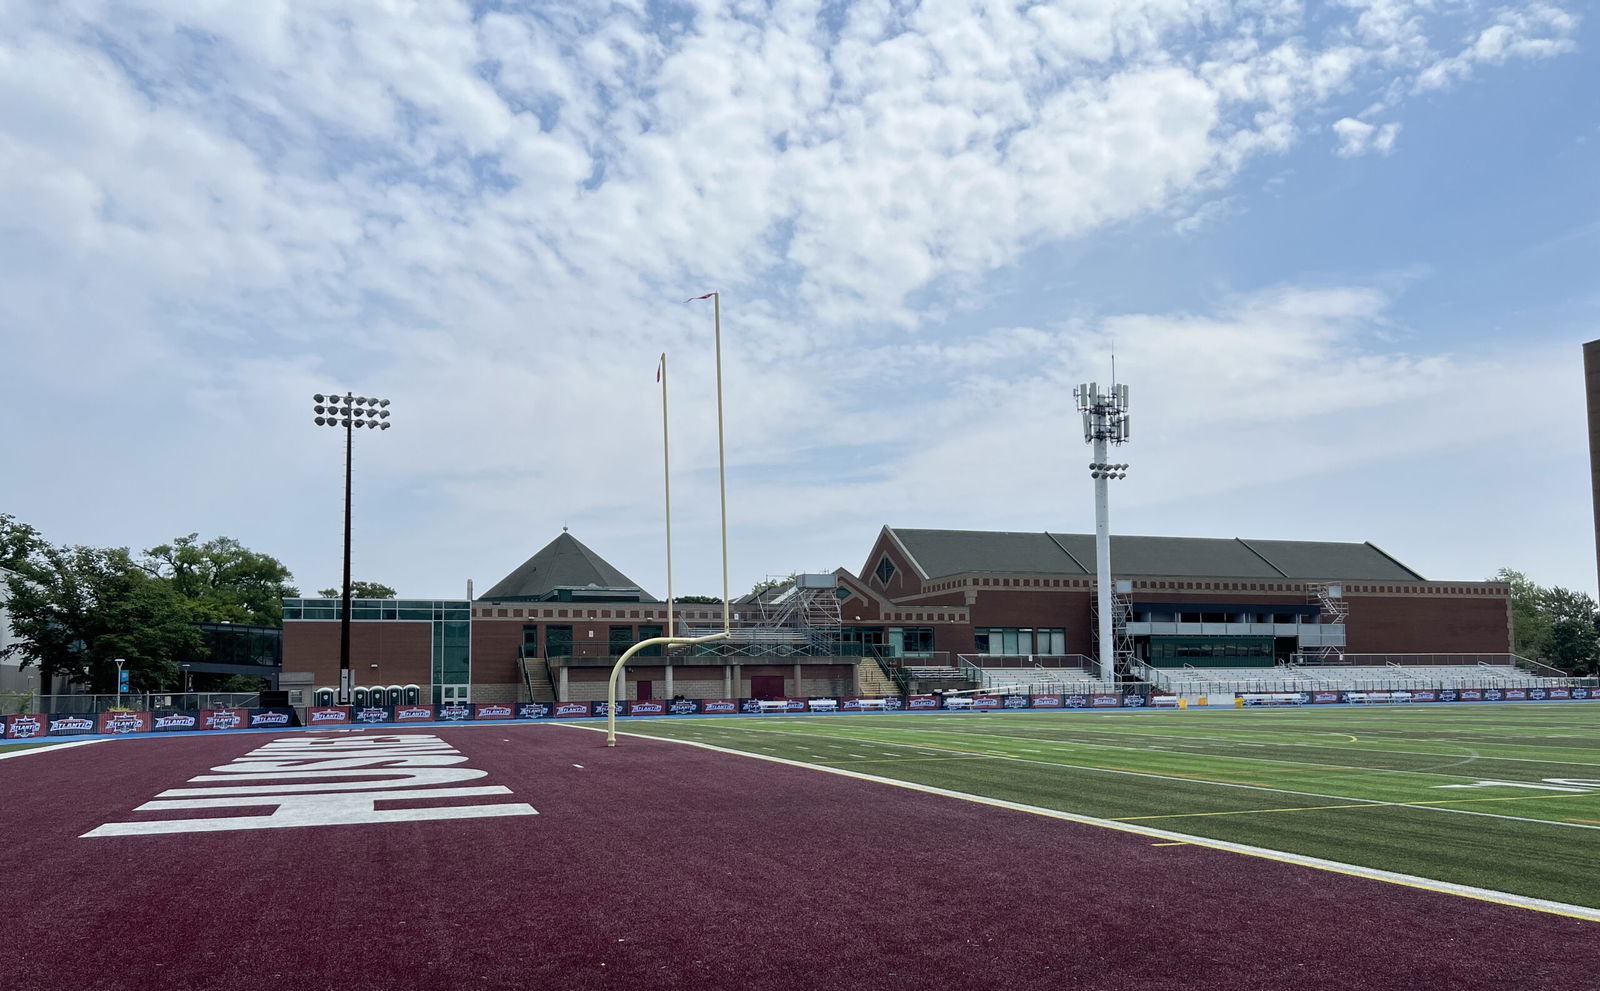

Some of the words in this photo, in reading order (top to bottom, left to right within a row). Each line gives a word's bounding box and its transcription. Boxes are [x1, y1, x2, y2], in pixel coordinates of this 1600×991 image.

[479, 707, 511, 716] ATLANTIC
[557, 706, 587, 715] ATLANTIC
[632, 704, 662, 712] ATLANTIC
[312, 712, 345, 721] ATLANTIC
[357, 711, 388, 719] ATLANTIC
[399, 709, 430, 719] ATLANTIC
[105, 719, 143, 729] ATLANTIC
[155, 717, 195, 728] ATLANTIC
[206, 716, 240, 726] ATLANTIC
[252, 714, 288, 725] ATLANTIC
[10, 722, 40, 733] ATLANTIC
[50, 720, 93, 731] ATLANTIC
[78, 734, 539, 838] HUSKIES
